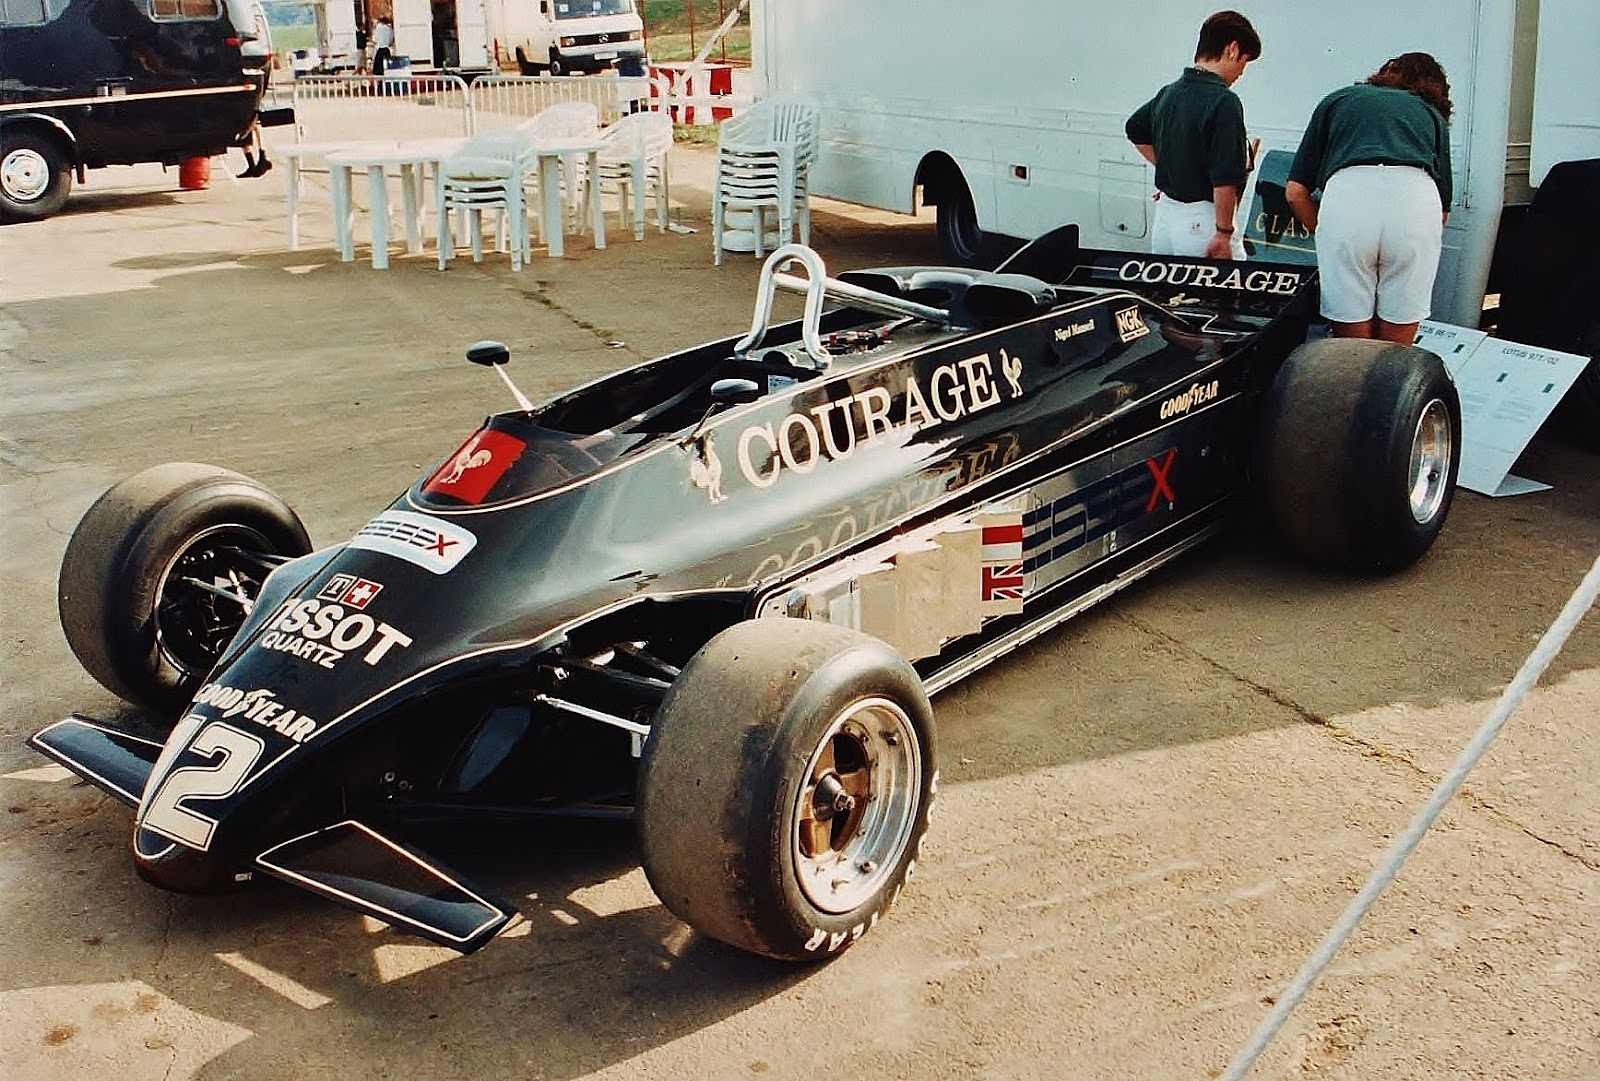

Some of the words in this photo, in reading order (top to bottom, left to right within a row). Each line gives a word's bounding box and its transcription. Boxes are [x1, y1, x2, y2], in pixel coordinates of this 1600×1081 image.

[1118, 259, 1301, 295] COURAGE
[1117, 308, 1143, 333] NGK
[1160, 380, 1219, 420] GOODYEAR
[737, 353, 1002, 489] COURAGE
[260, 631, 345, 670] QUARTZ
[136, 713, 266, 852] 12
